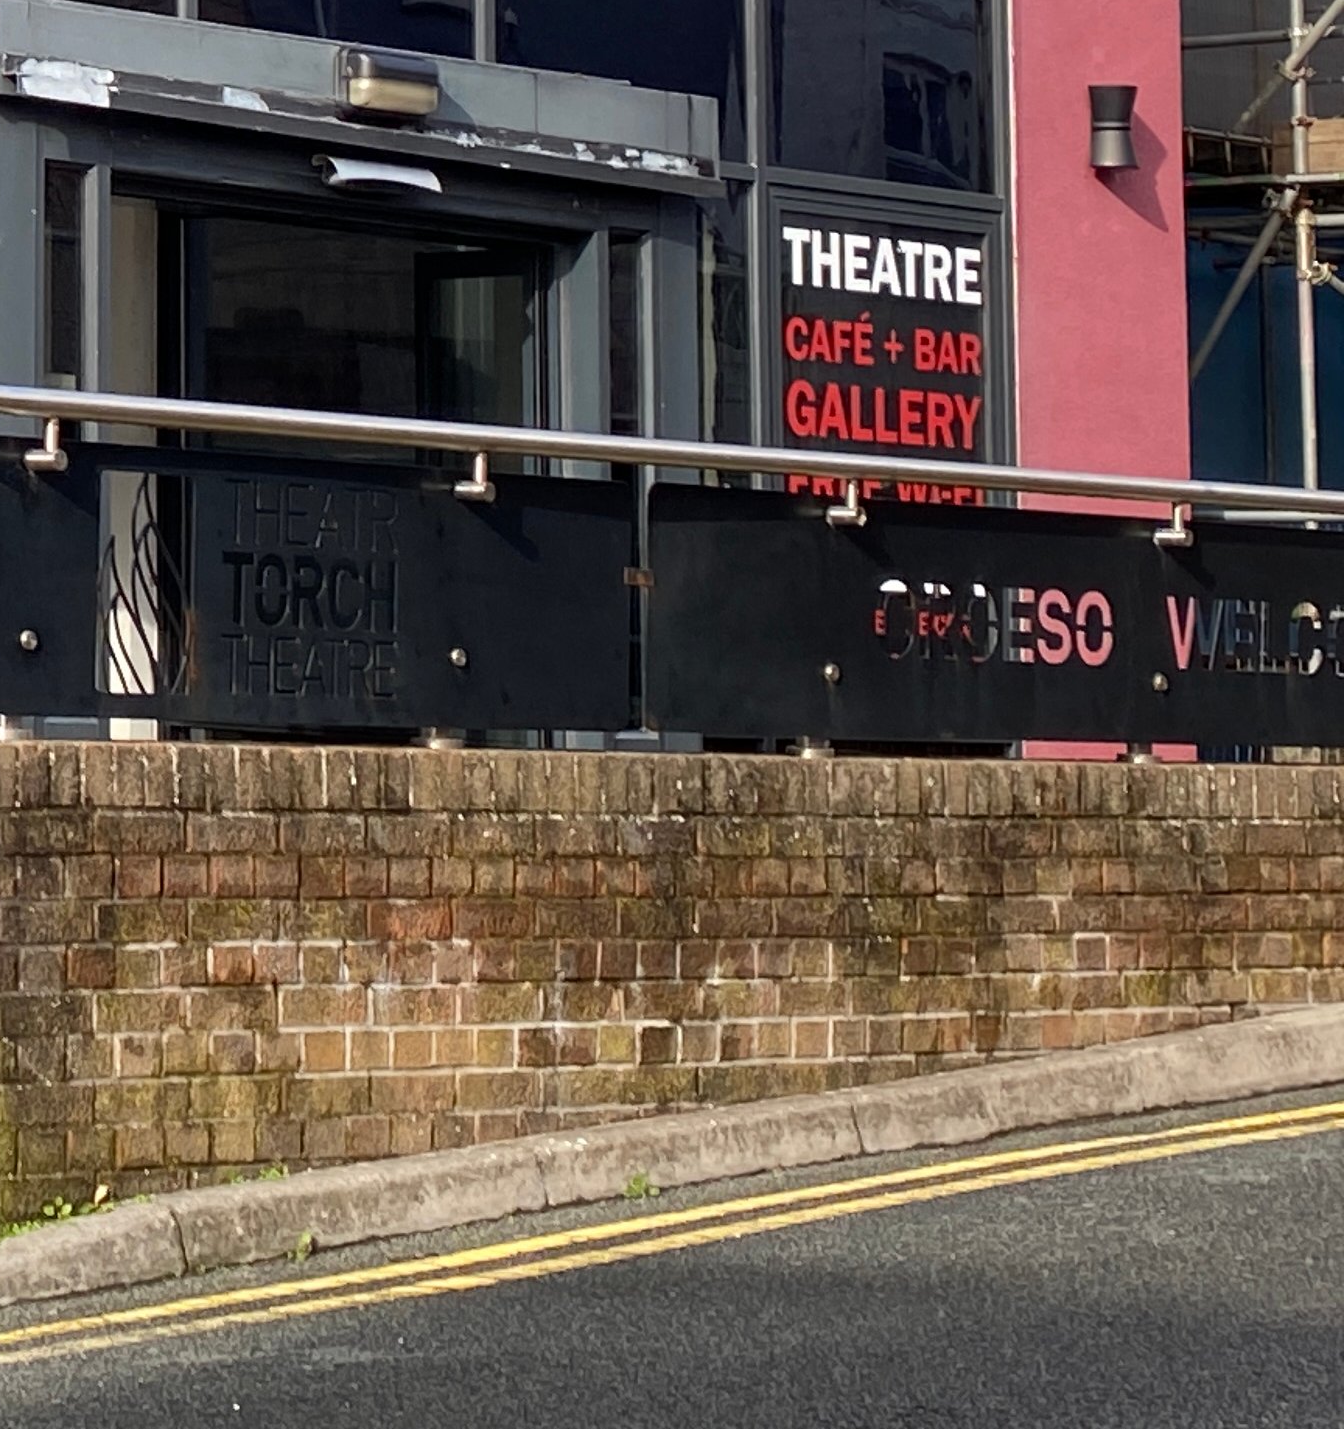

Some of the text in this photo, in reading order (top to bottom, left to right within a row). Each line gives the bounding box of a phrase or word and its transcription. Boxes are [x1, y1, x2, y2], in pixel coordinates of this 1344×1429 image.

[782, 226, 982, 305] THEATRE
[785, 311, 875, 366] CAFÉ
[914, 328, 982, 376] BAR
[786, 379, 982, 450] GALLERY
[222, 550, 400, 634] TORCH
[873, 577, 1114, 668] CROESO
[221, 634, 400, 700] THEATRE
